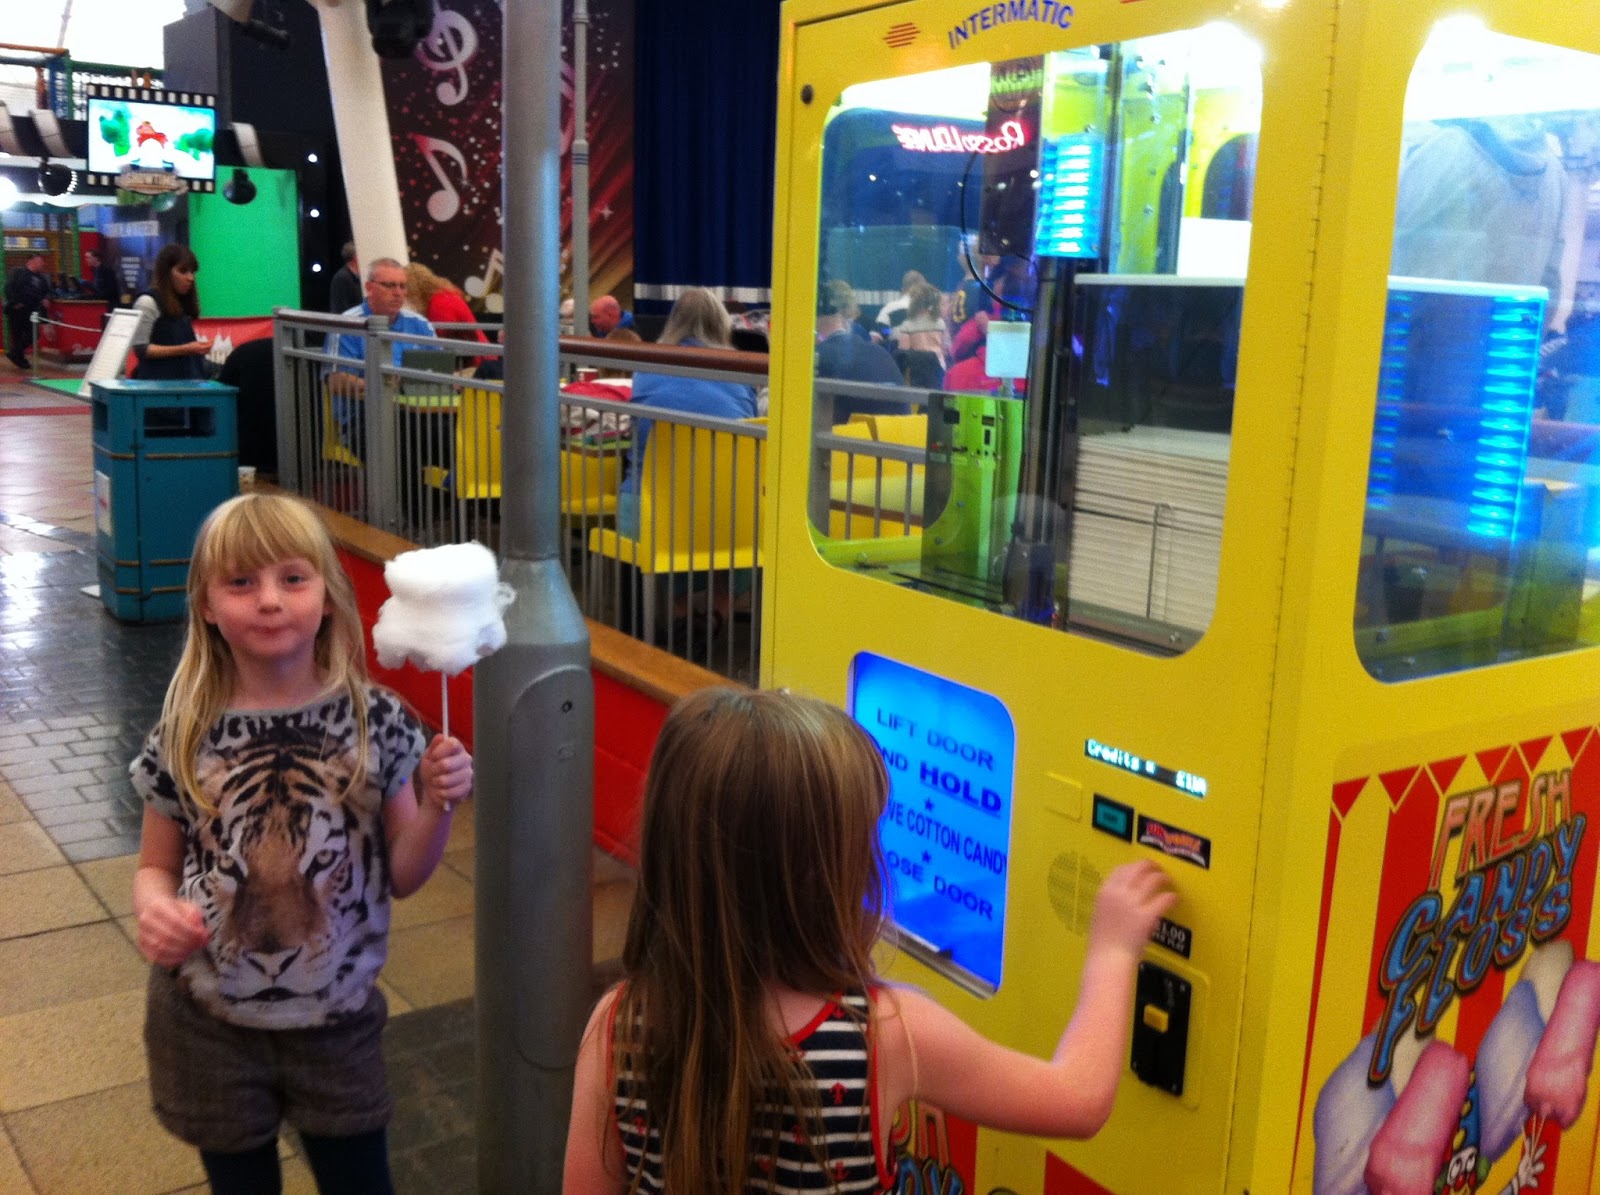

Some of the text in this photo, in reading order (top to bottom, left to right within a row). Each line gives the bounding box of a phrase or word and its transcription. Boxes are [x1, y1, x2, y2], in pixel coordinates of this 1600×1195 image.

[948, 0, 1074, 49] INTERMATIC
[876, 707, 994, 772] LIFT DOOR
[881, 747, 909, 772] ND
[919, 760, 1003, 813] HOLD
[906, 808, 962, 855] COTTON
[1427, 769, 1572, 892] FRESH
[886, 850, 994, 922] OSE DOOR
[1380, 814, 1587, 992] CANDY
[1368, 879, 1572, 1086] FLOSS
